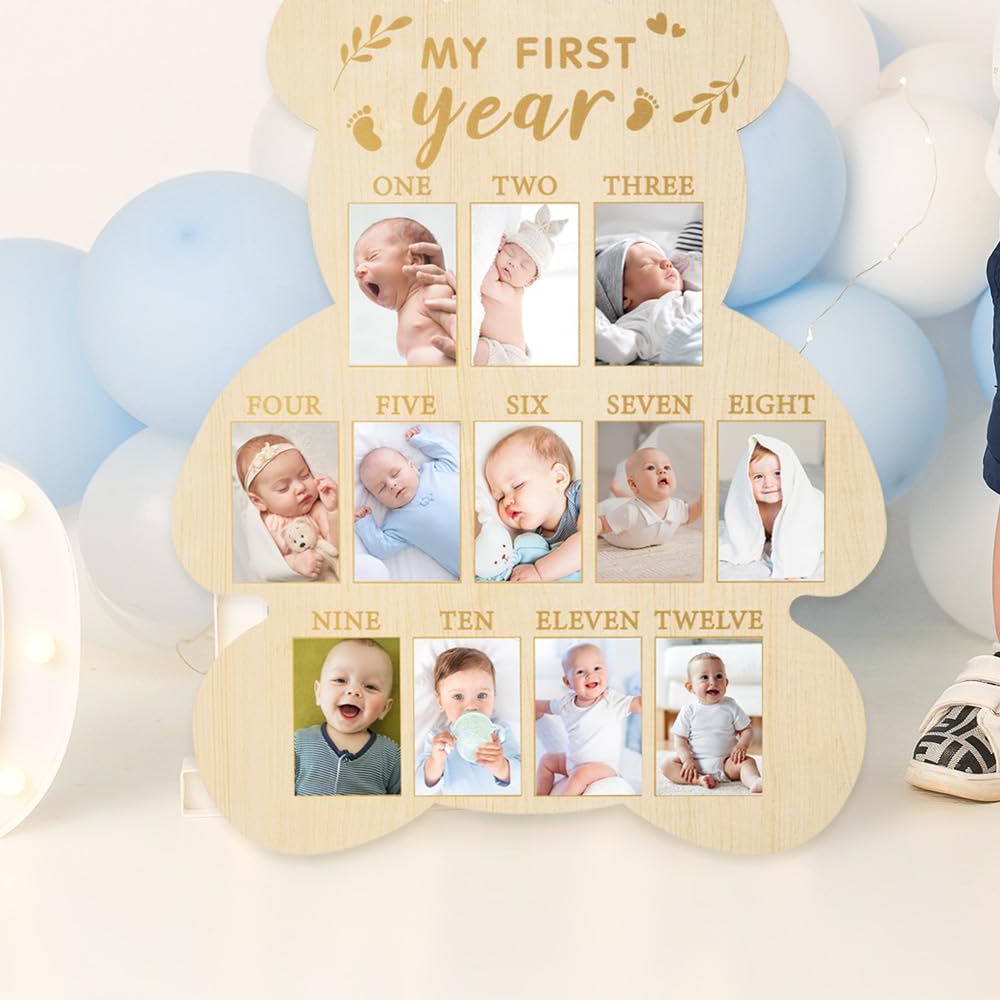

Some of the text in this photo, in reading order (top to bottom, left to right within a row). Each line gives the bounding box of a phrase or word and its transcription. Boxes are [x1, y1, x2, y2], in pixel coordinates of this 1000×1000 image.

[421, 35, 637, 70] MY FIRST
[411, 86, 616, 170] year
[372, 175, 433, 197] ONE
[491, 174, 558, 197] TWO
[602, 175, 695, 197] THREE
[246, 394, 322, 416] FOUR
[375, 394, 437, 416] FIVE
[505, 394, 550, 416] SIX
[606, 394, 693, 416] SEVEN
[727, 394, 816, 416] EIGHT
[311, 610, 381, 631] NINE
[439, 610, 495, 631] TEN
[535, 610, 641, 631] ELEVEN
[653, 610, 764, 631] TWELVE
